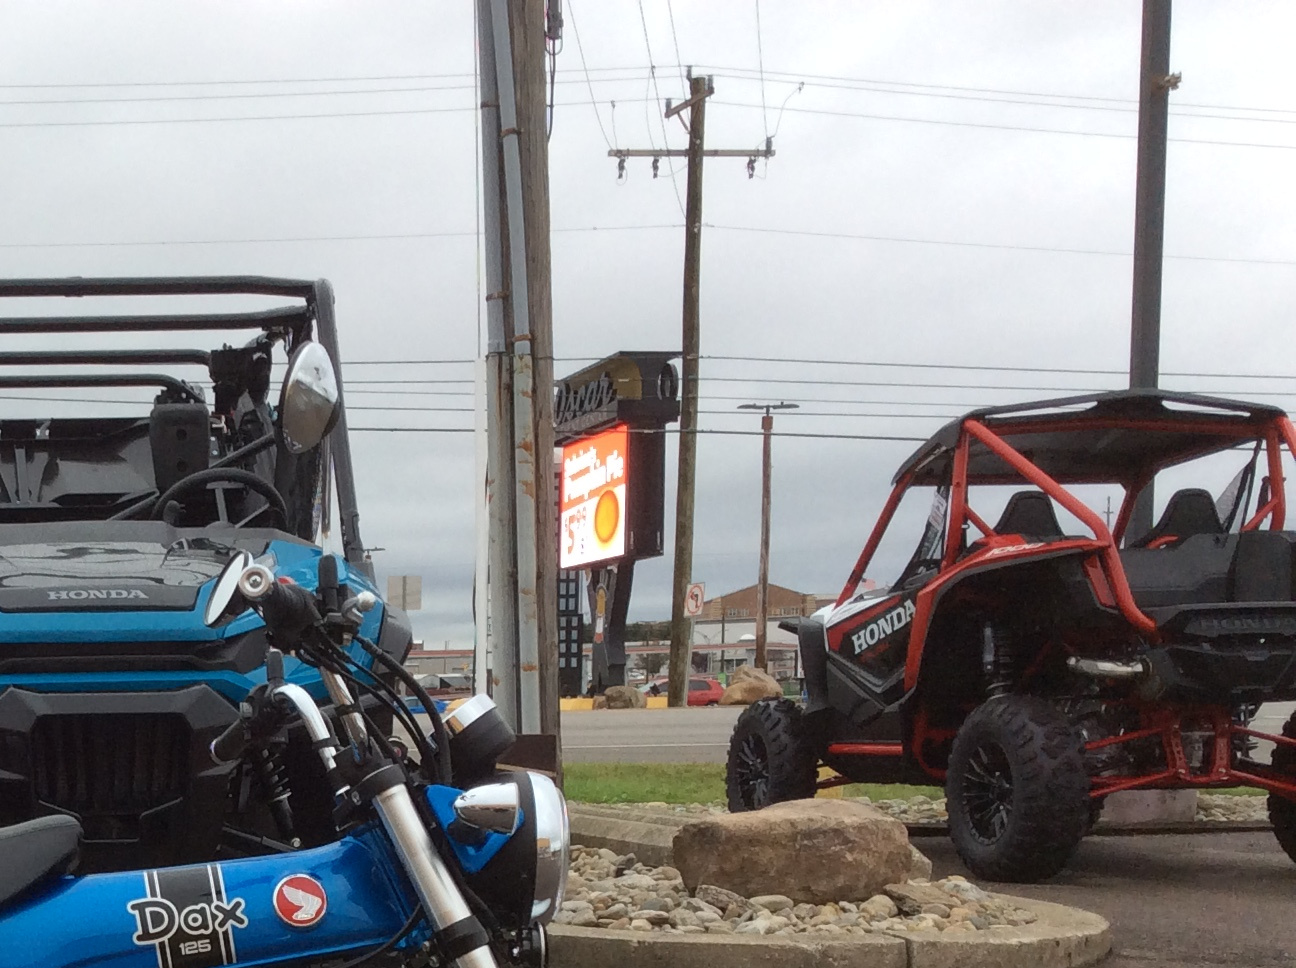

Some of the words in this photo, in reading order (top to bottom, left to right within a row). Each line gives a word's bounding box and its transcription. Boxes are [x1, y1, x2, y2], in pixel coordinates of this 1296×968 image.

[47, 589, 150, 600] HONDA
[851, 599, 917, 655] HONDA
[126, 897, 249, 946] Dax
[179, 939, 212, 955] 125
